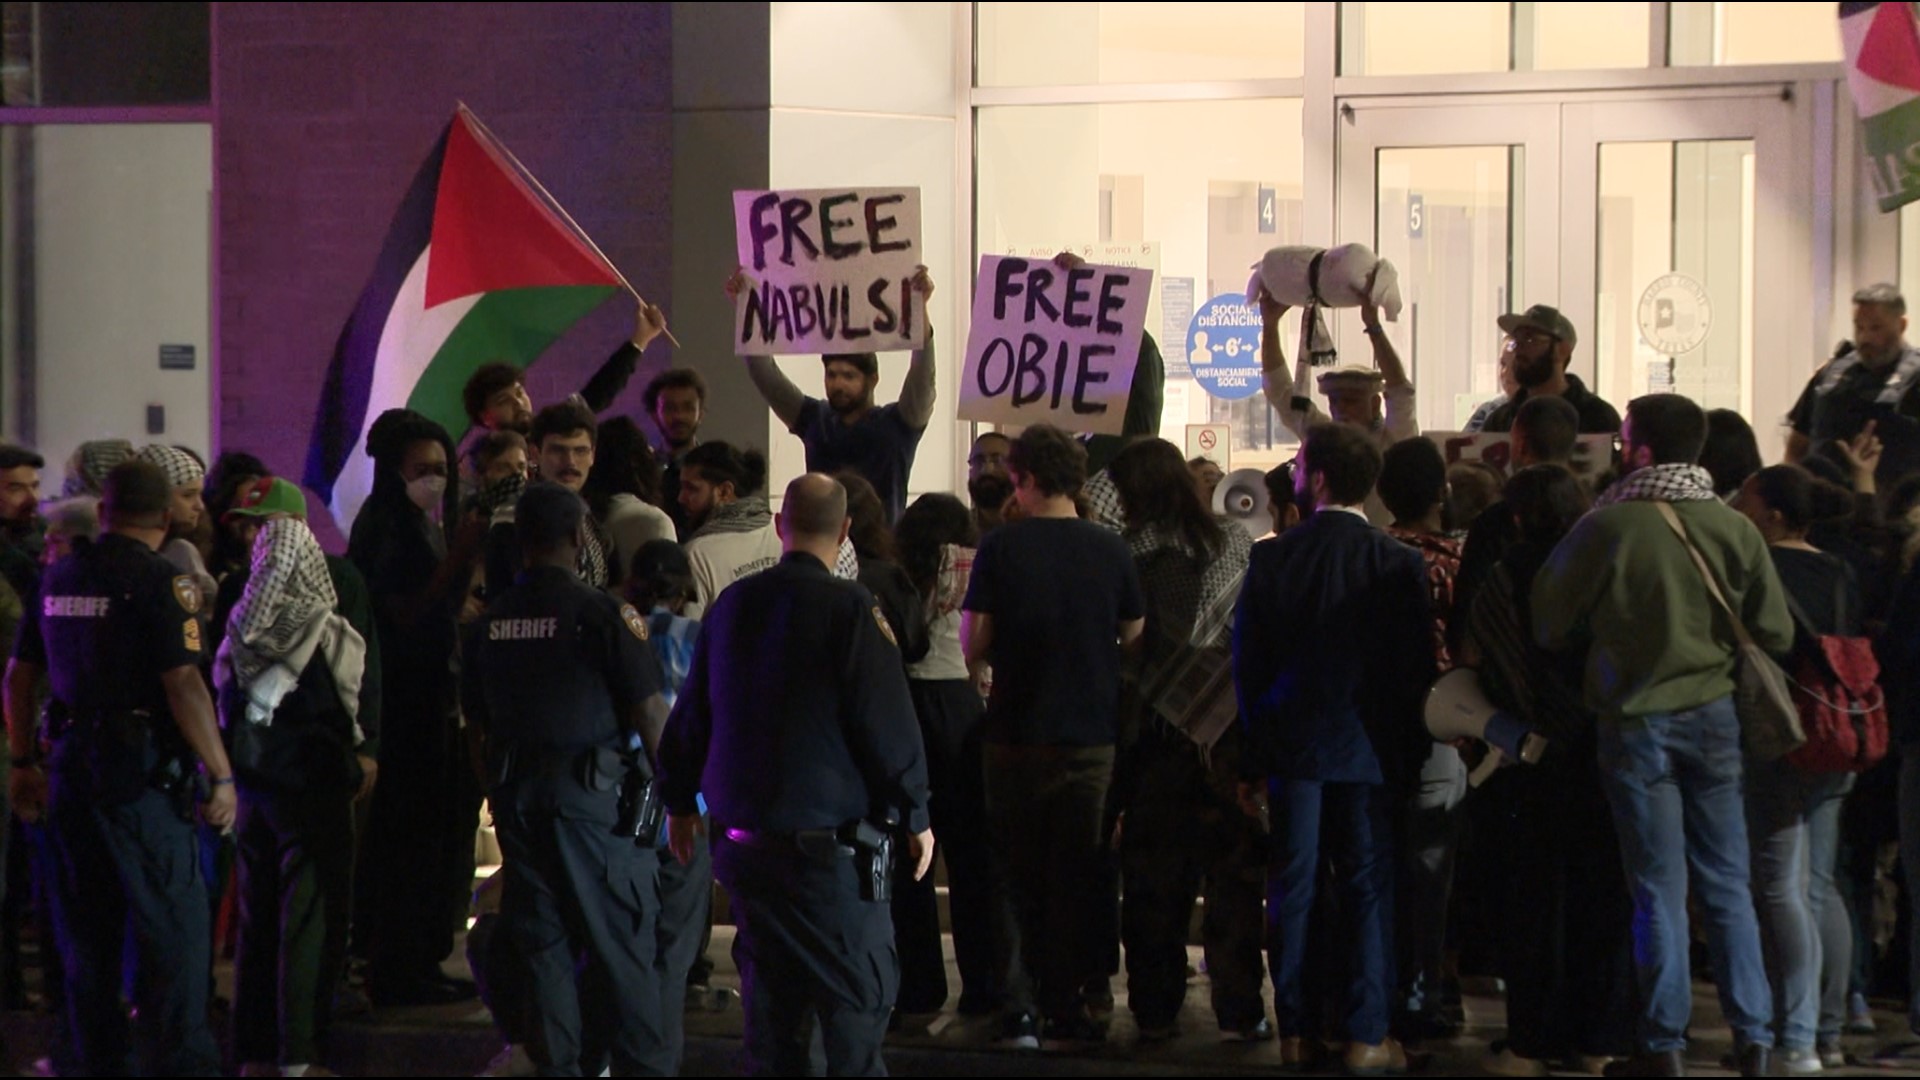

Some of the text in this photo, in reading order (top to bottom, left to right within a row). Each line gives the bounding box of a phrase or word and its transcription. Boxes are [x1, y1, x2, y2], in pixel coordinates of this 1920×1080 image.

[1262, 197, 1273, 225] 4
[1410, 203, 1421, 230] 5
[749, 192, 911, 271] FREE
[993, 257, 1130, 335] FREE
[741, 277, 912, 344] NABULSI
[1211, 304, 1254, 316] SOCIAL
[977, 333, 1116, 414] OBIE
[1196, 367, 1264, 378] DISTANCIAMIENT
[1217, 377, 1248, 387] SOCIAL
[44, 595, 110, 617] SHERIFF
[489, 617, 557, 641] SHERIFF
